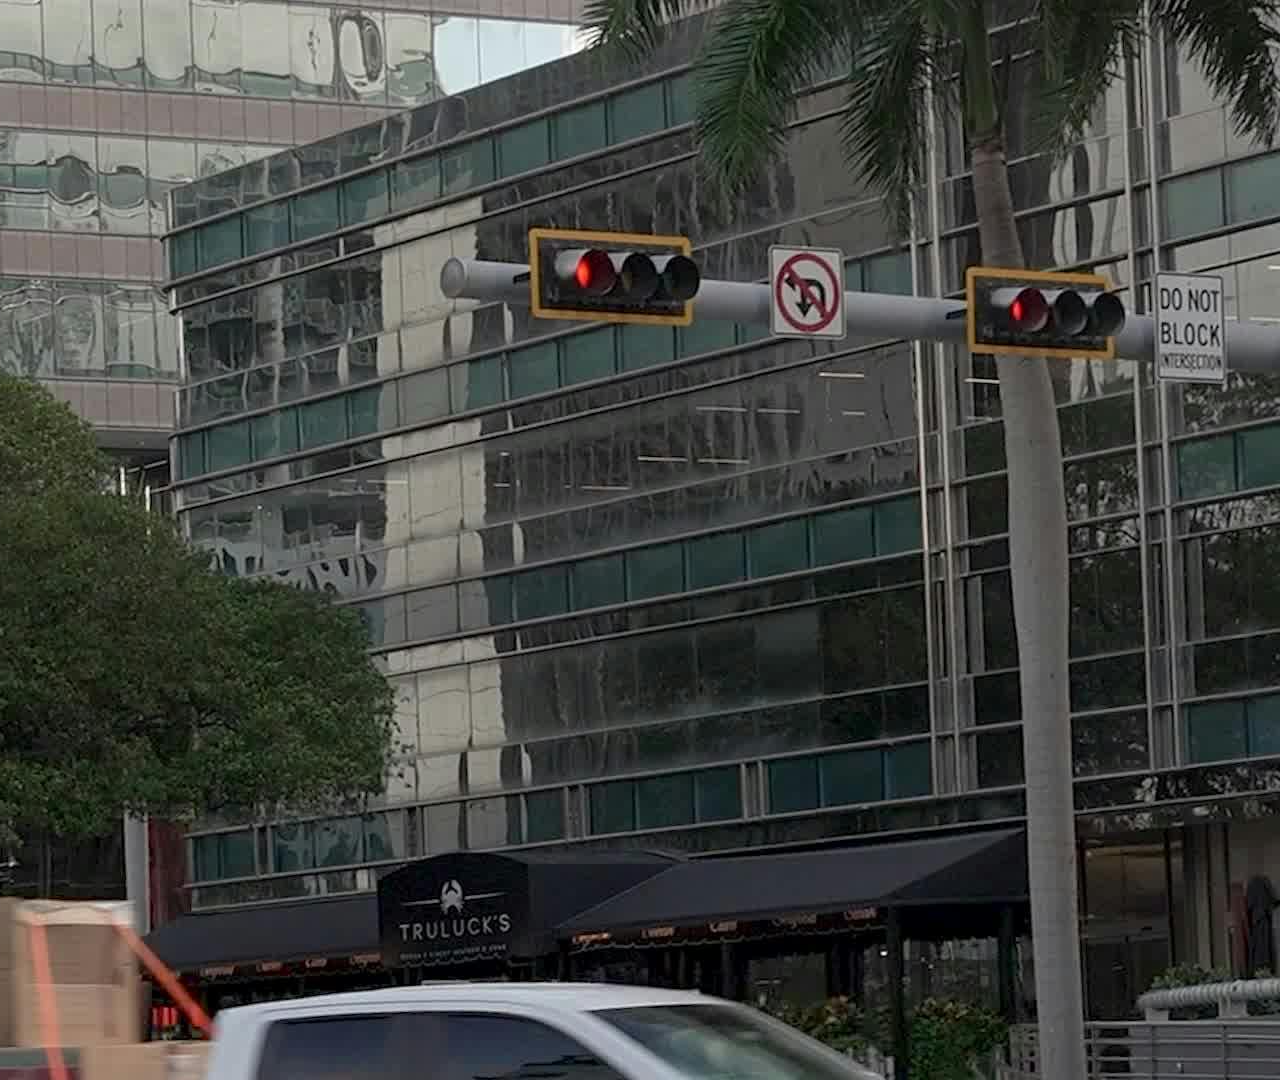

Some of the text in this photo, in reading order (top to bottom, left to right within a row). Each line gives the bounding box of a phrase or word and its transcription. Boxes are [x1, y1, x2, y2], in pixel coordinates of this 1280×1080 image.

[1160, 287, 1220, 313] DO NOT
[1160, 322, 1221, 346] BLOCK
[1160, 353, 1222, 370] INTERSECTION
[399, 913, 511, 941] TRULUCK'S
